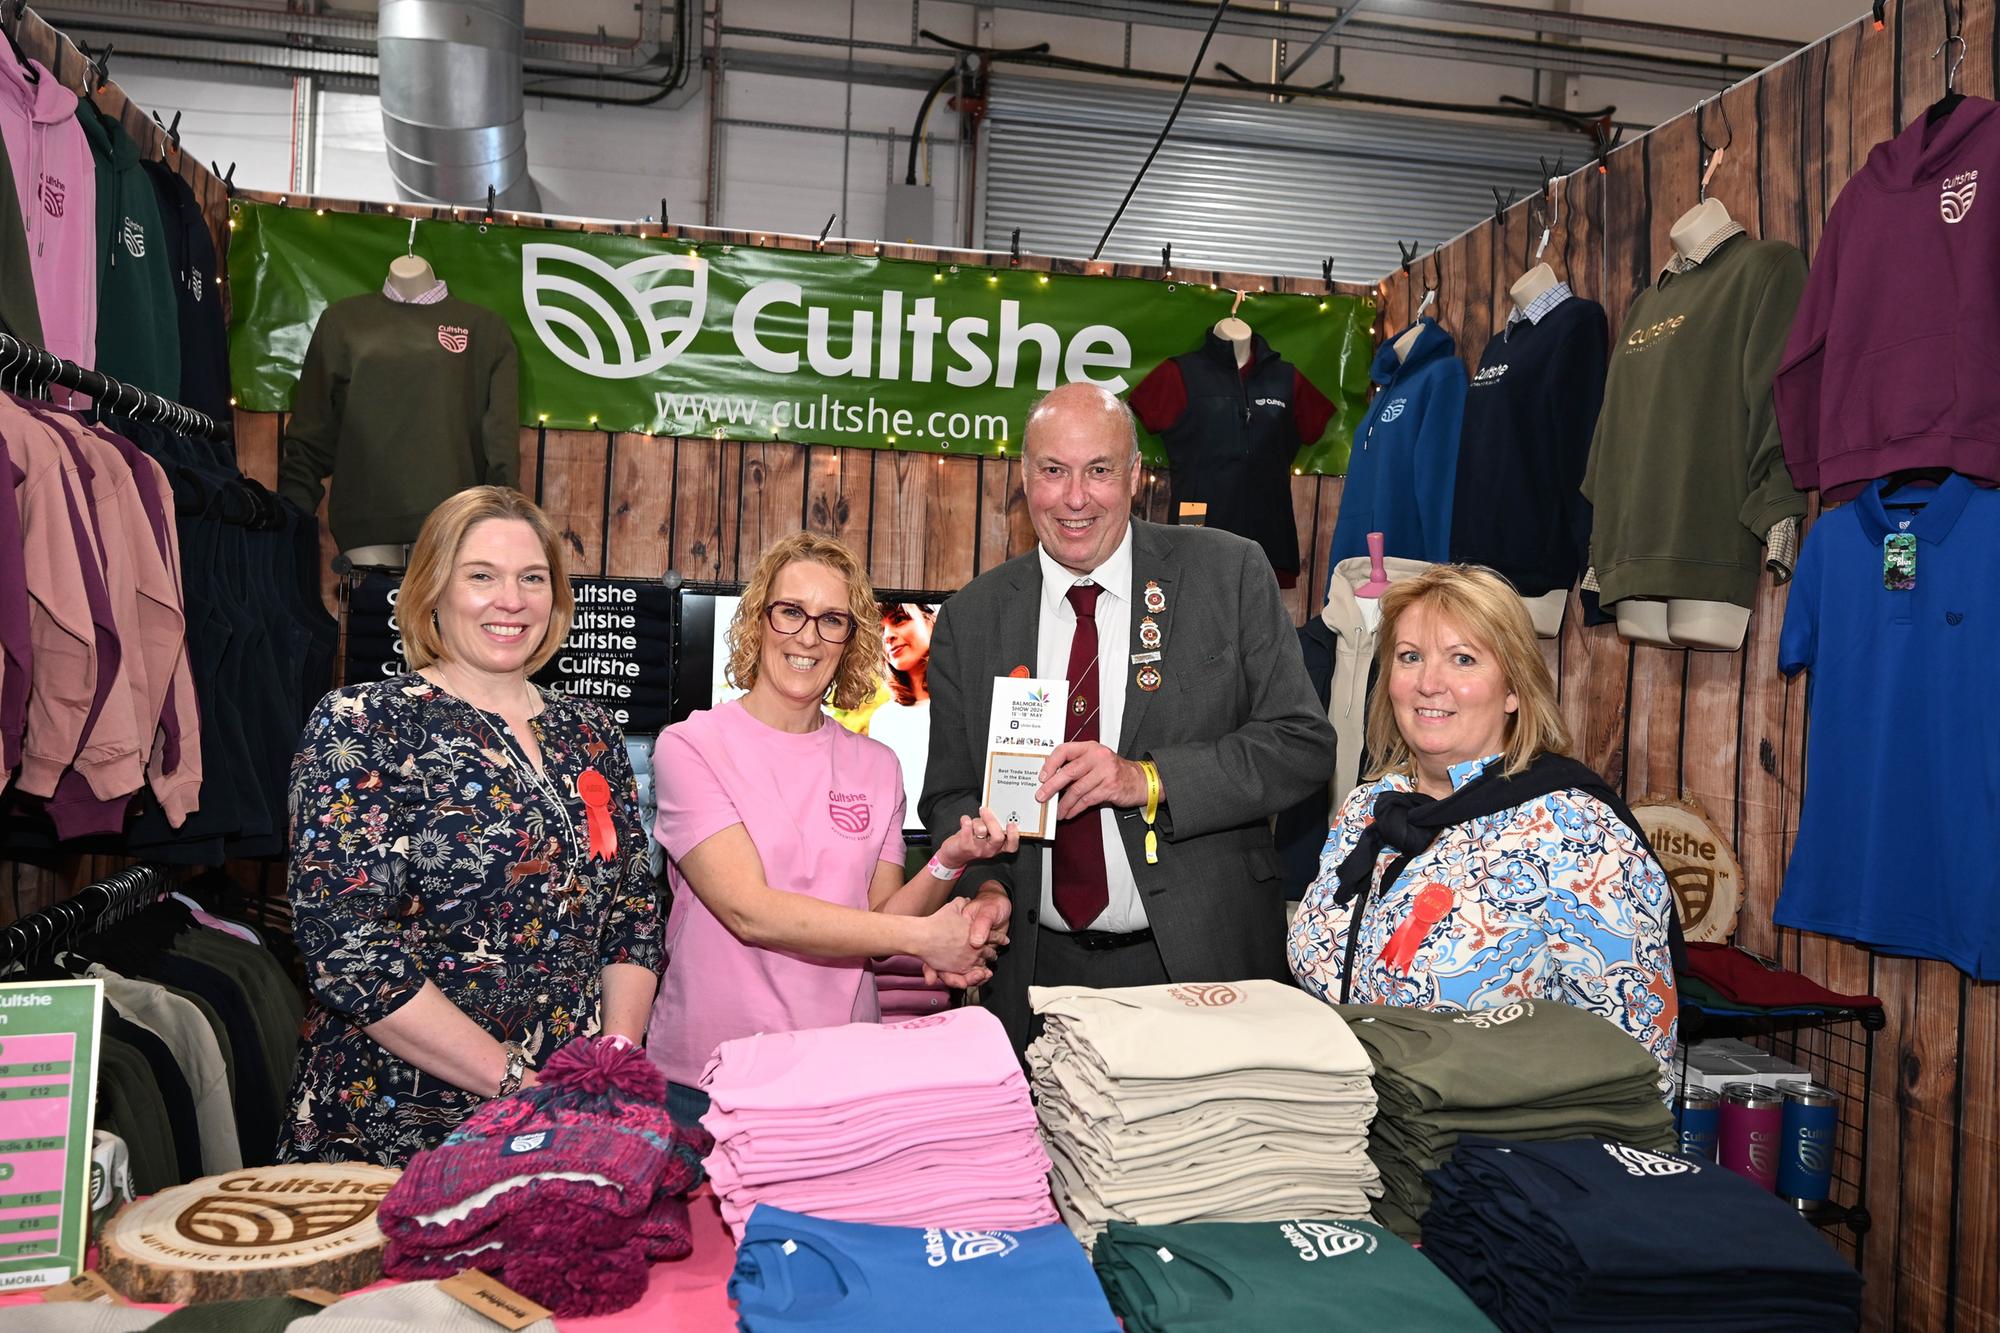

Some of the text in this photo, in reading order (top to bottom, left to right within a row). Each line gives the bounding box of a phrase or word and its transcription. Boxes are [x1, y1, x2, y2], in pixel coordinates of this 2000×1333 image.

[1942, 170, 1978, 190] Cultshe
[438, 325, 469, 335] Cultshe
[732, 280, 1132, 394] Cultshe
[655, 390, 1009, 441] www.cultshe.com
[1887, 552, 1905, 562] Cool
[571, 584, 637, 603] ultshe
[570, 612, 636, 629] ultshe
[558, 656, 640, 677] Cultshe
[550, 678, 632, 698] Cultshe
[829, 790, 867, 802] Cultshe
[1700, 923, 1718, 942] LIFE
[218, 1177, 392, 1195] Cultshe
[139, 1232, 358, 1262] AUTHENTIC RURAL LIFE
